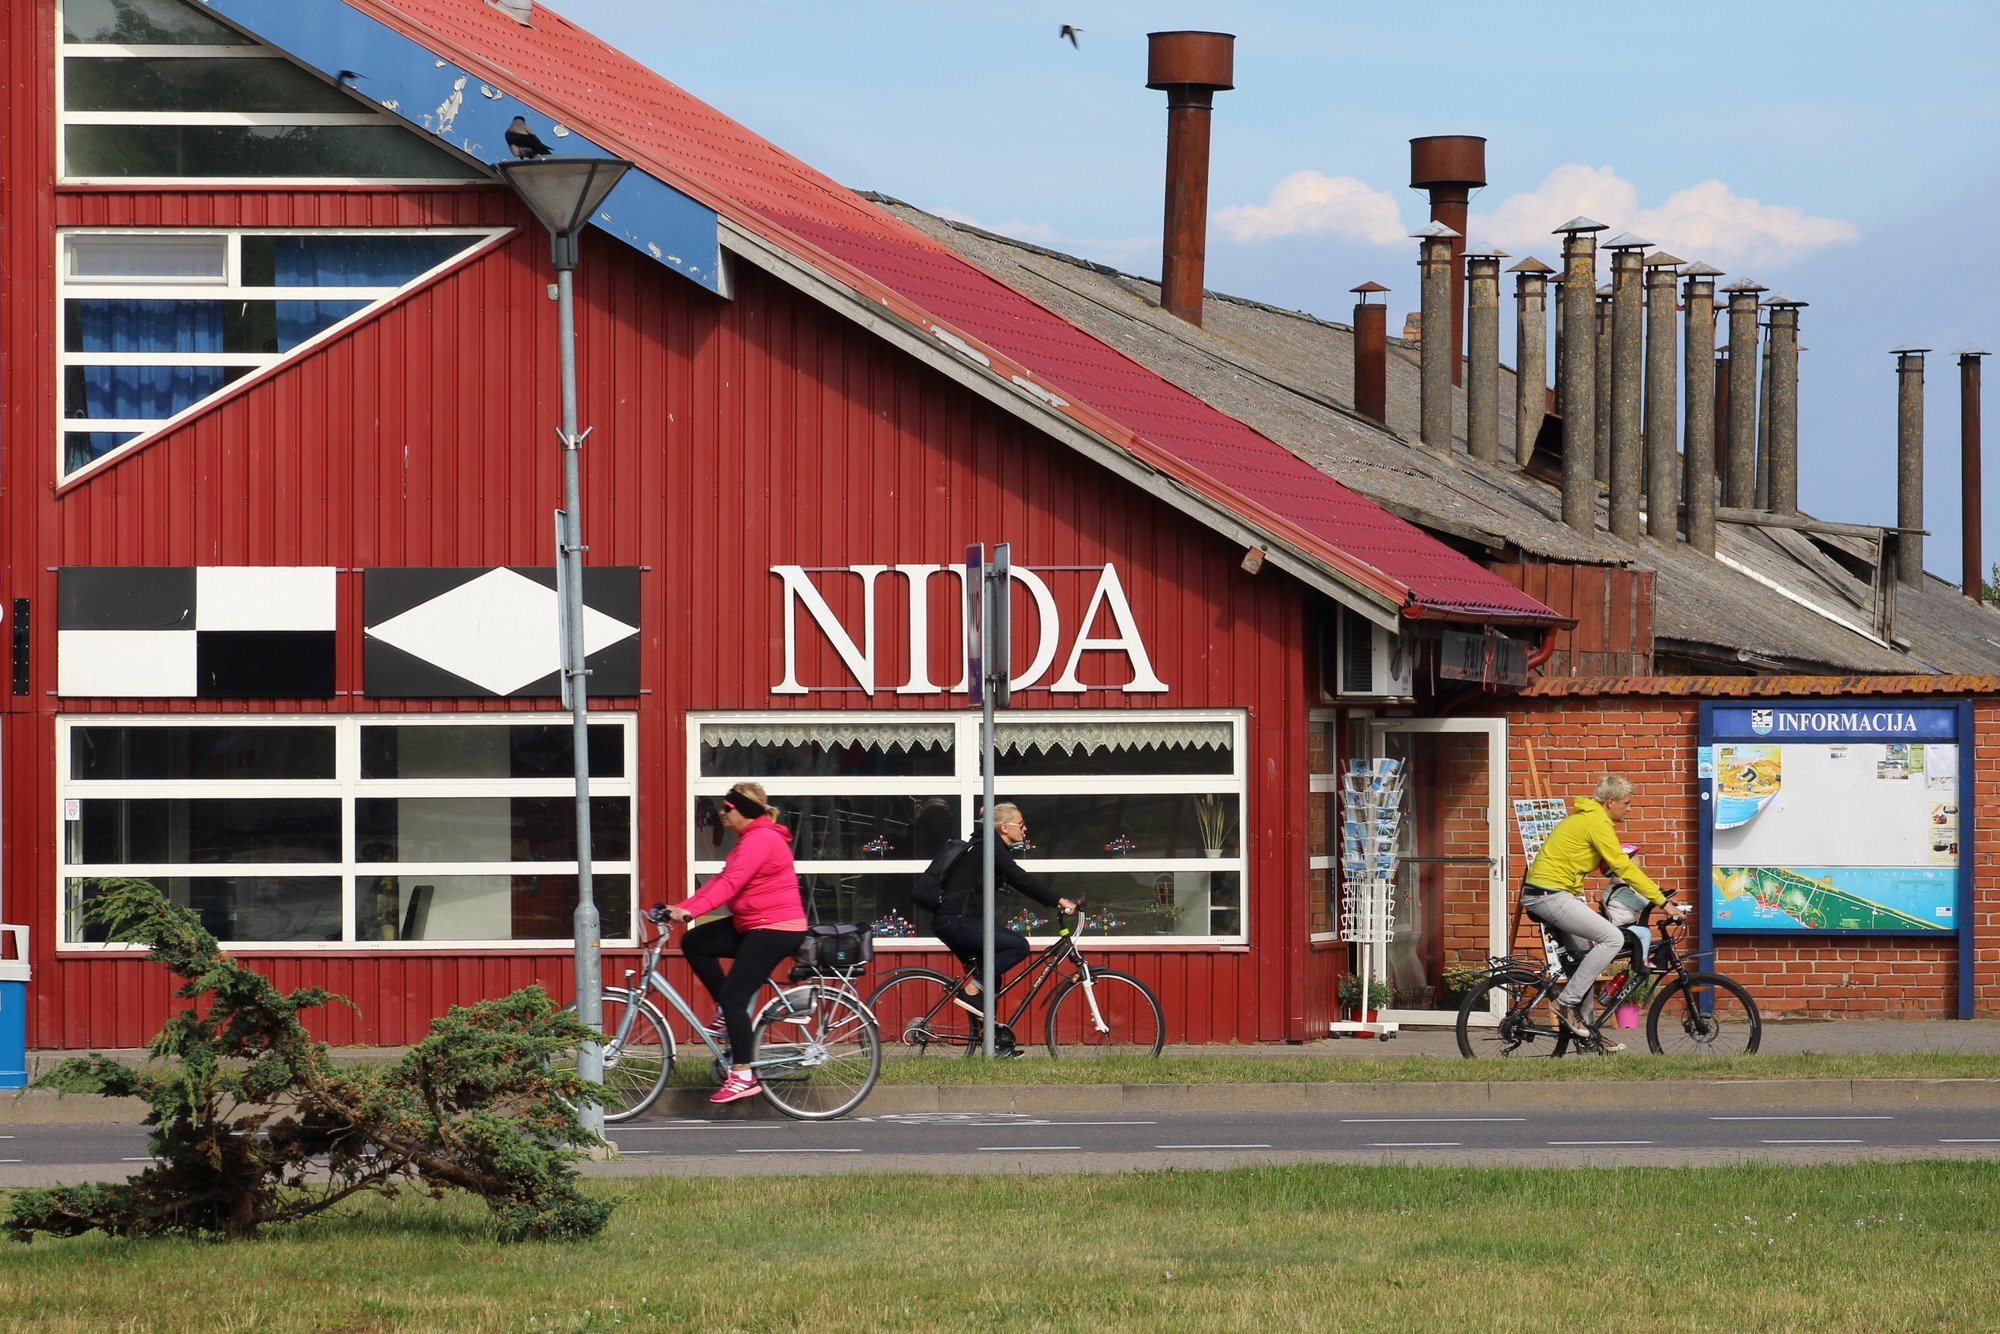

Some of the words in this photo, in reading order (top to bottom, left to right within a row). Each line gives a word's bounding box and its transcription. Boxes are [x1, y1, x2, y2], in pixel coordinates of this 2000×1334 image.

[769, 562, 1169, 696] NIDA
[968, 591, 980, 633] WC
[1777, 712, 1918, 732] INFORMACIJA
